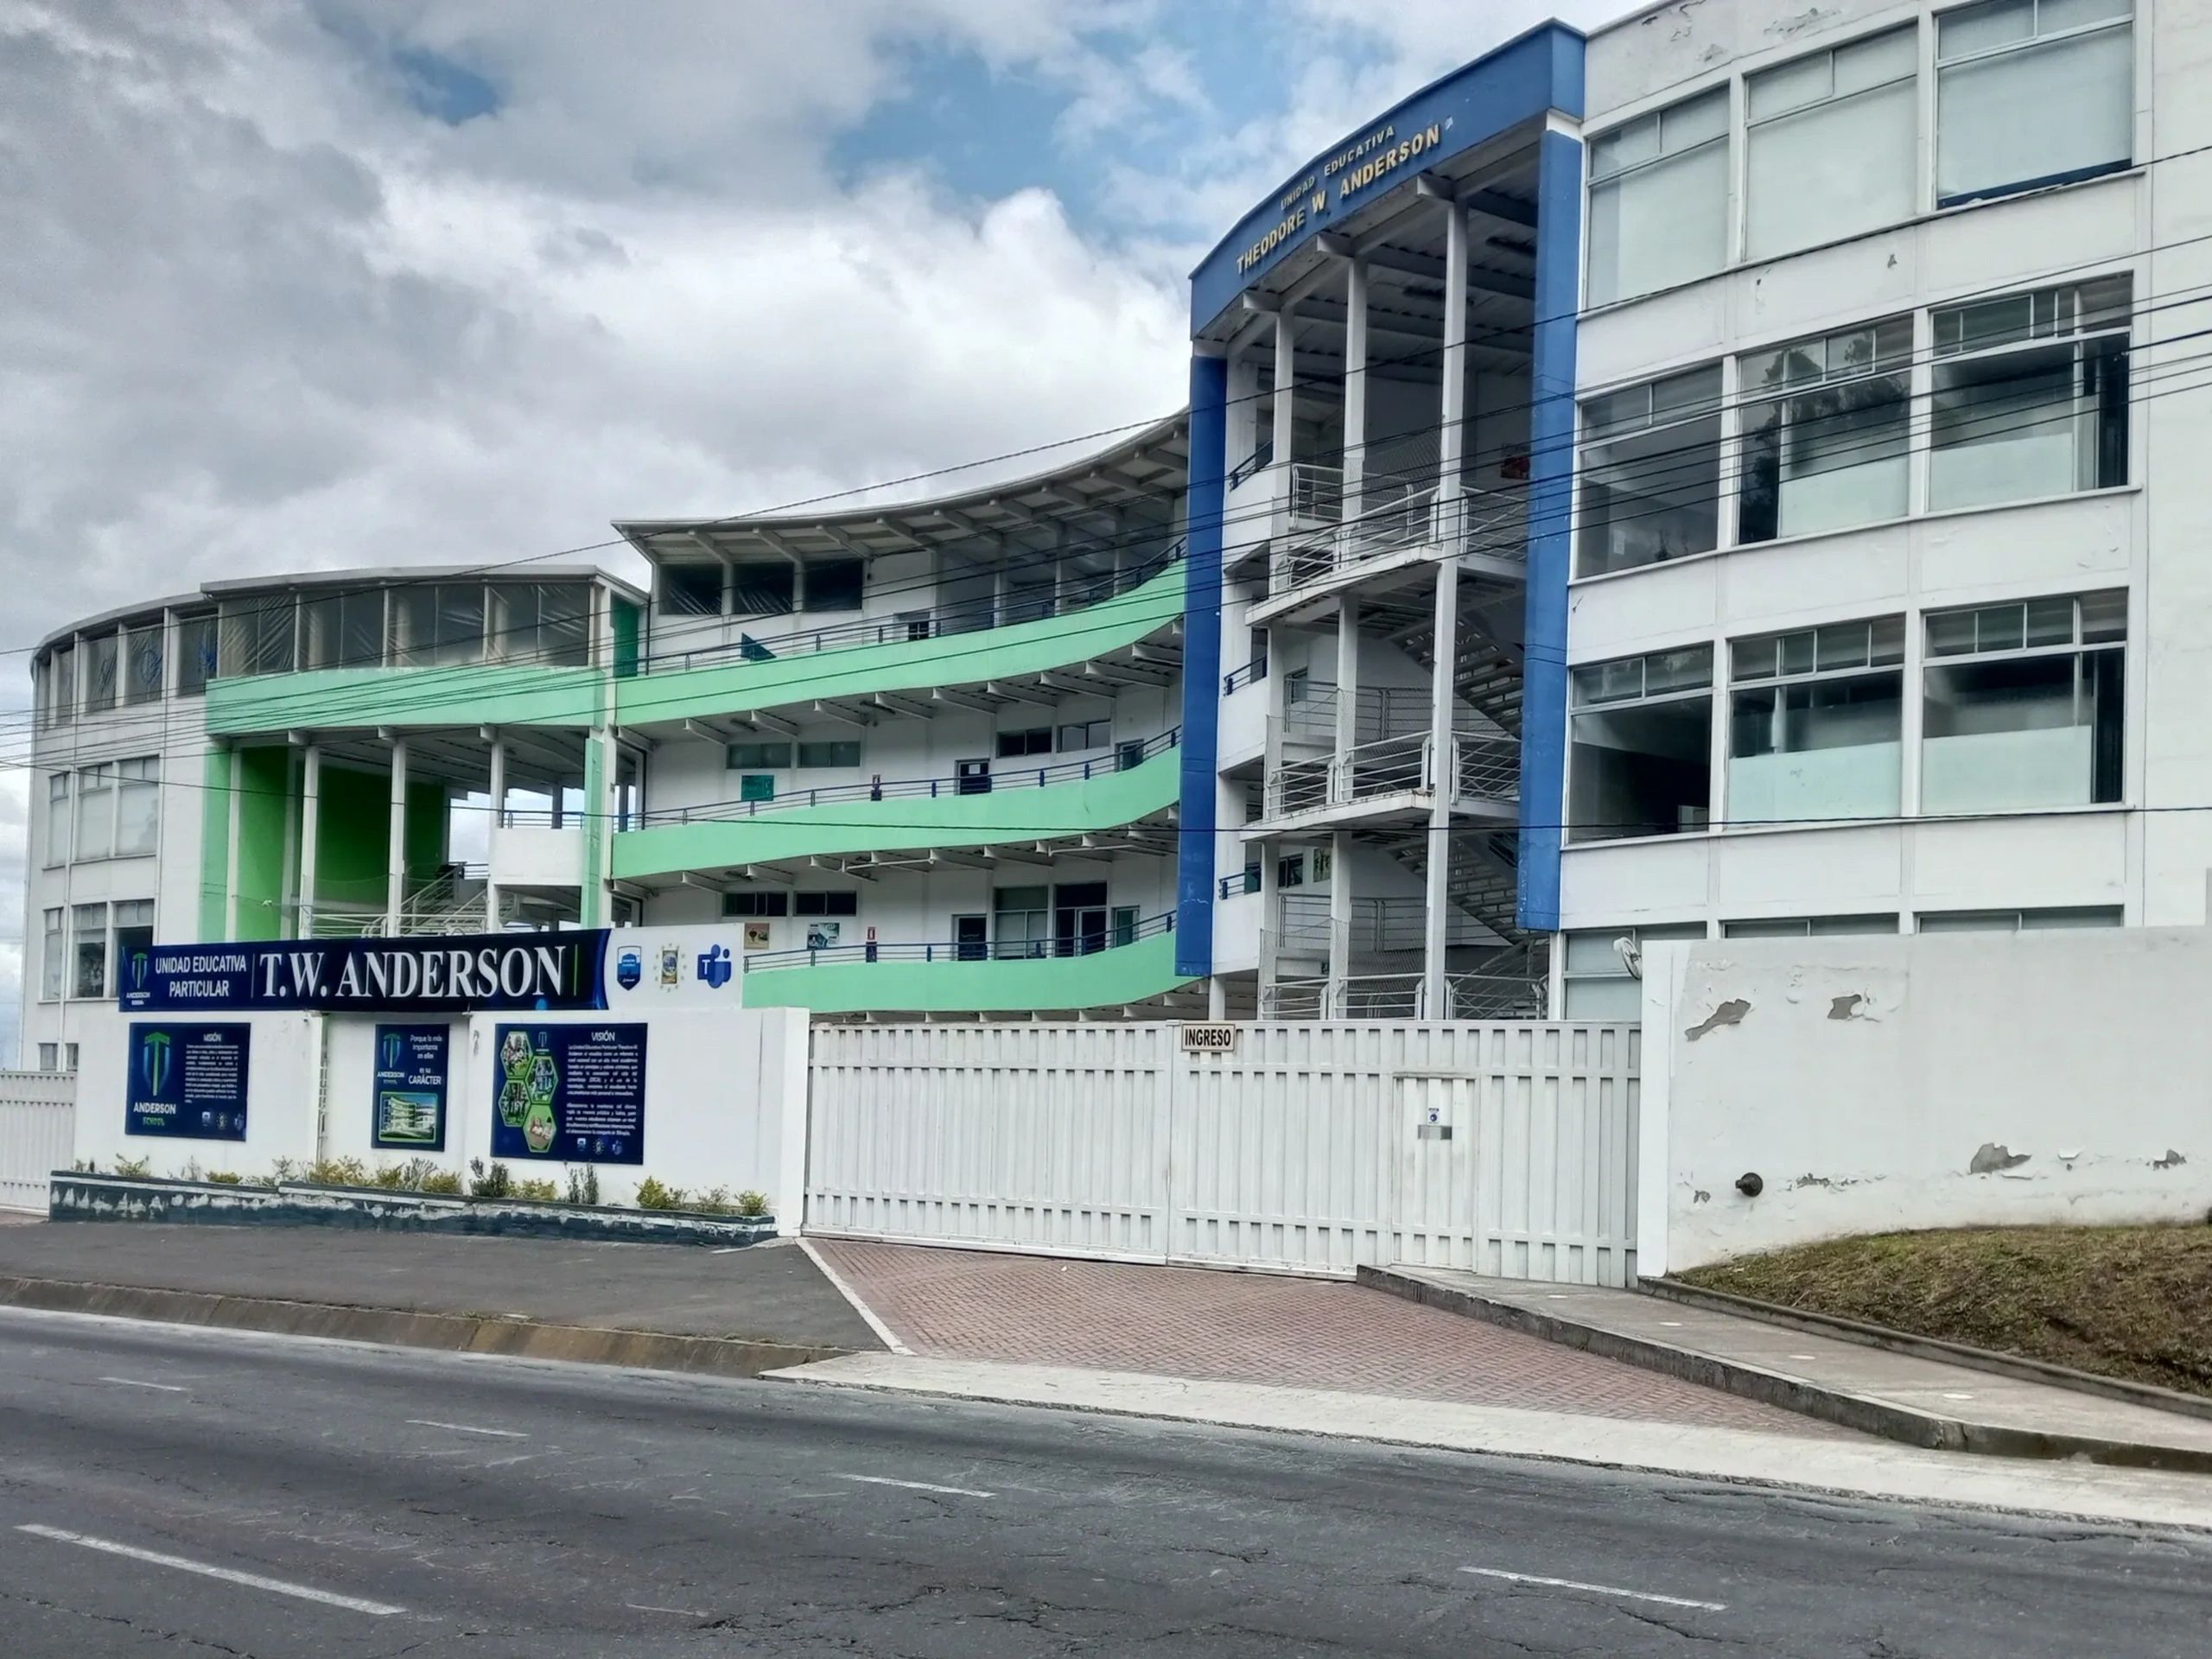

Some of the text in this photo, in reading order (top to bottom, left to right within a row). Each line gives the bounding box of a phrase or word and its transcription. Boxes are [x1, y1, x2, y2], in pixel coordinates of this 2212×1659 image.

[1281, 124, 1395, 211] UNIDAD EDUCATIVA
[1236, 207, 1306, 275] THEODORE
[1339, 124, 1440, 198] ANDERSON
[156, 955, 246, 974] UNIDAD EDUCATIVA
[260, 946, 566, 998] T.W. ANDERSON
[169, 980, 230, 997] PARTICULAR
[591, 1030, 615, 1042] VISIÓN
[1185, 1028, 1232, 1047] INGRESO
[408, 1074, 442, 1085] CARÁCTER
[133, 1102, 176, 1115] ANDERSON
